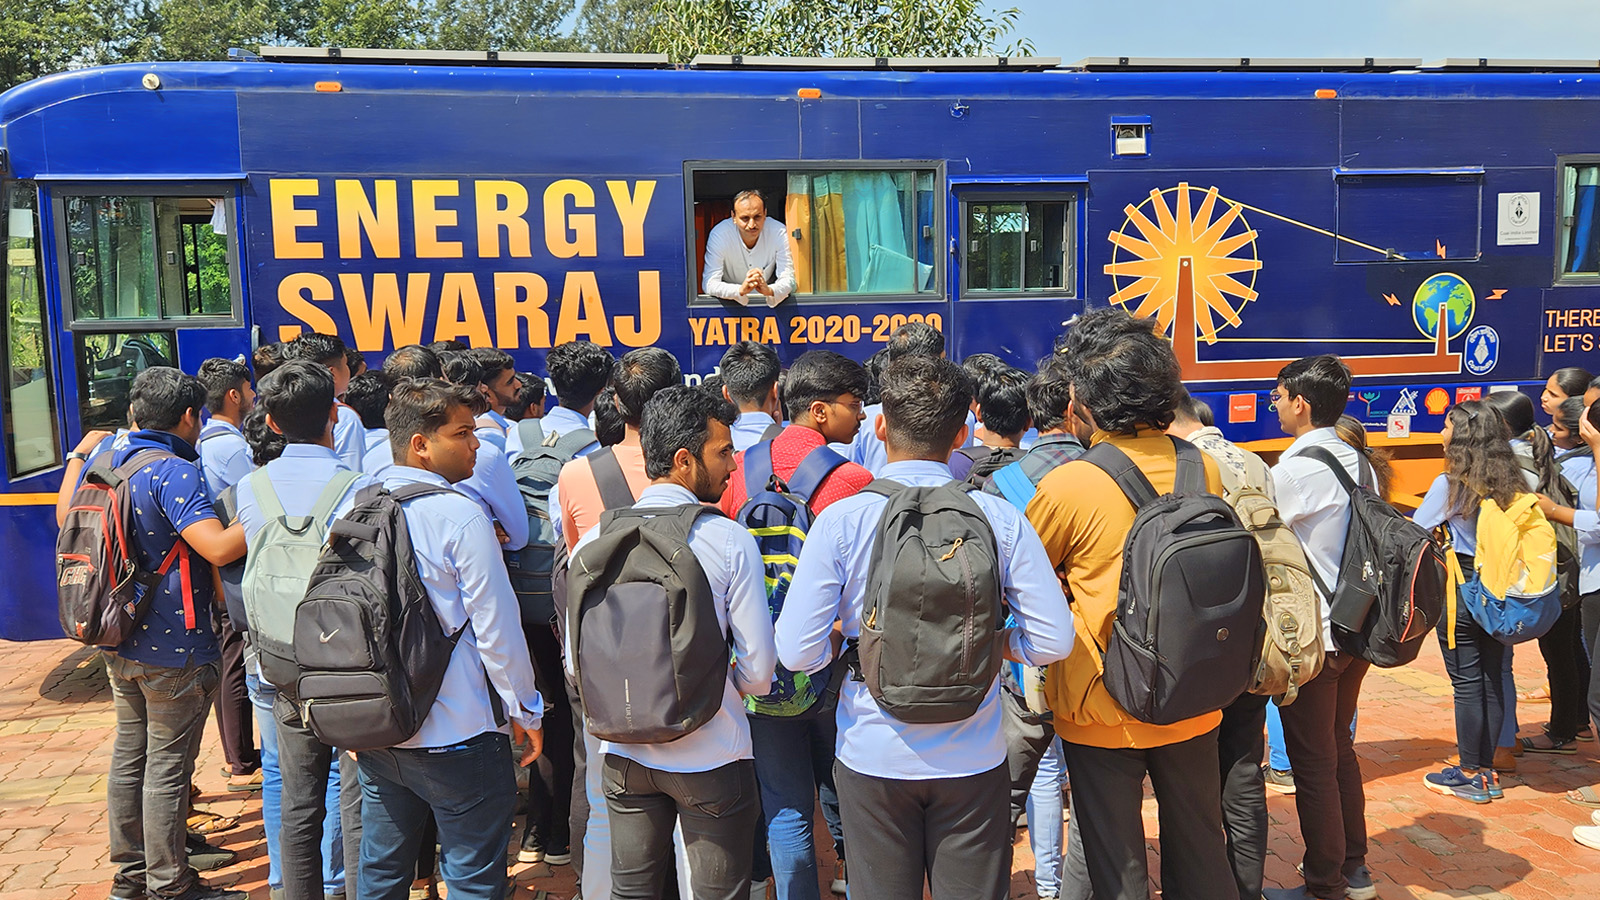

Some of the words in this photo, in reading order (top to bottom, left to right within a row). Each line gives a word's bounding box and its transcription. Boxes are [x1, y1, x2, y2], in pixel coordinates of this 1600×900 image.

[269, 179, 657, 259] ENERGY
[277, 270, 662, 352] SWARAJ
[688, 315, 781, 346] YATRA
[1543, 333, 1594, 353] LET'S
